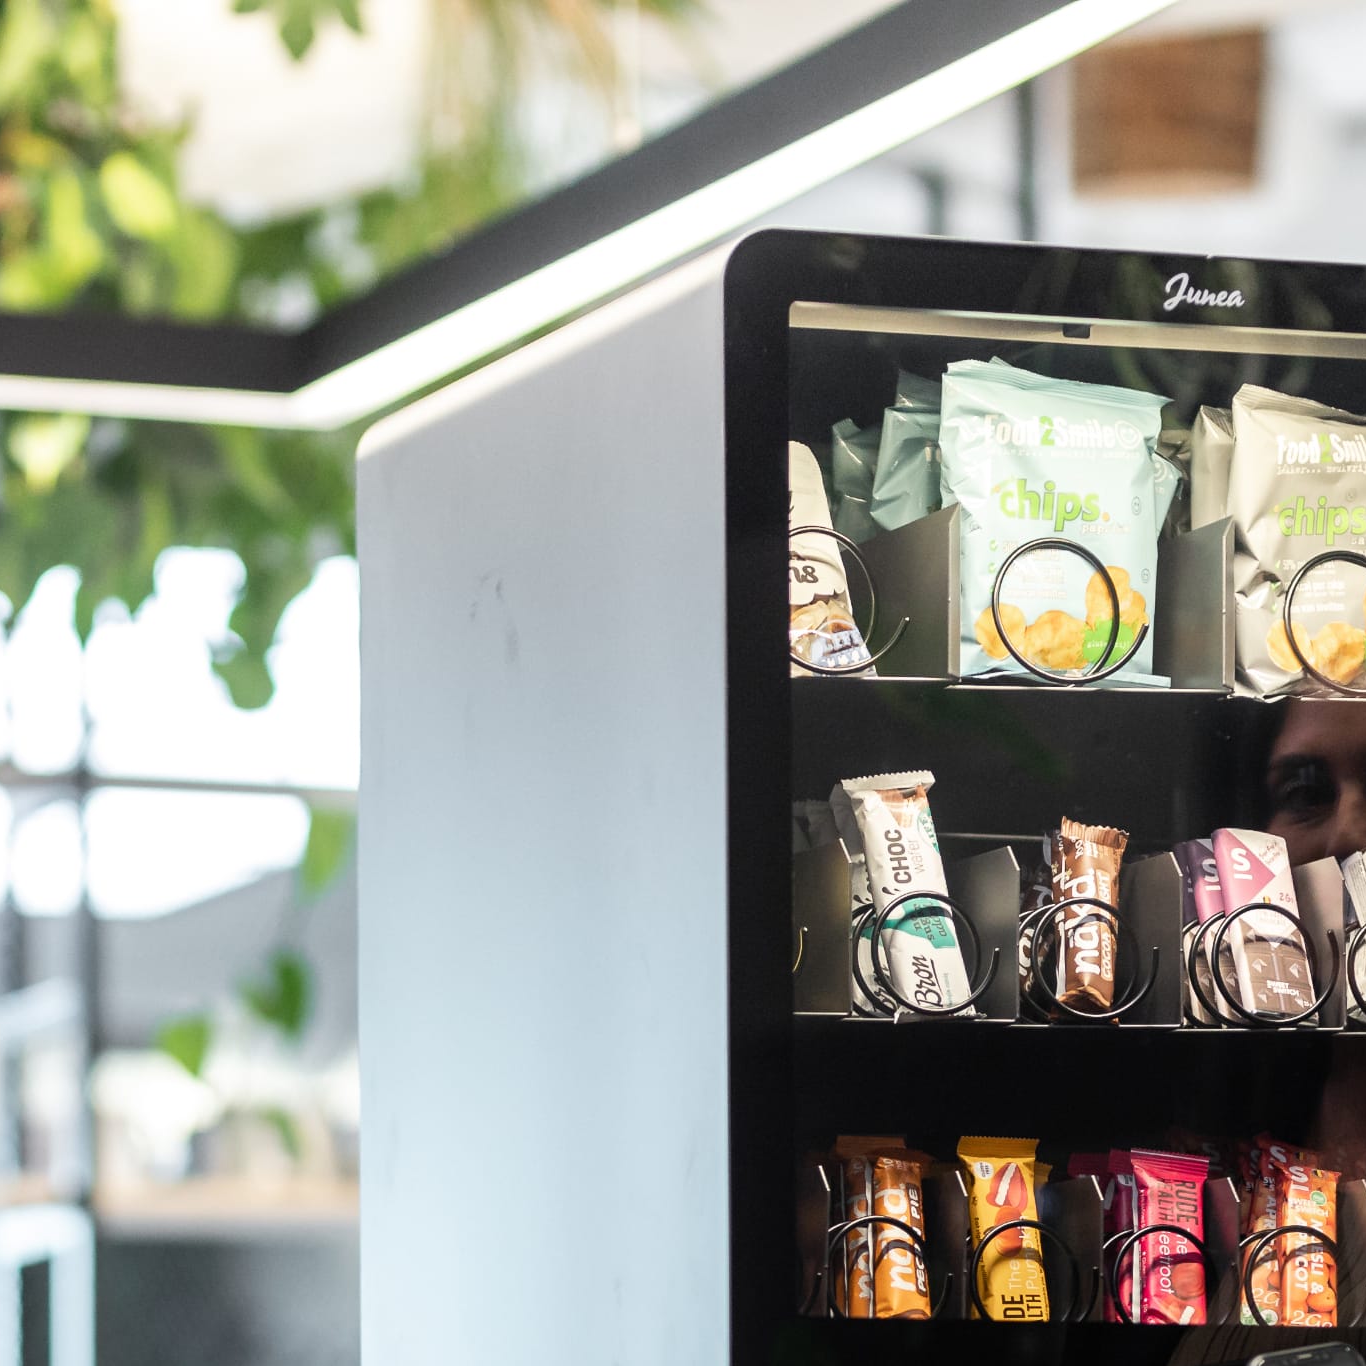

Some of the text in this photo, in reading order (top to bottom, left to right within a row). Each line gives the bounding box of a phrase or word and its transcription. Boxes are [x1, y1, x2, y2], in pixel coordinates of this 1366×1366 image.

[1163, 272, 1245, 312] Junea
[985, 415, 1116, 449] Food2Smile
[884, 828, 912, 884] CHOC
[908, 1187, 919, 1219] PIE
[1175, 1179, 1198, 1226] RUDE
[1176, 1228, 1191, 1256] he
[1009, 1260, 1021, 1289] The
[1158, 1230, 1175, 1295] eetroot
[1311, 1282, 1324, 1294] &
